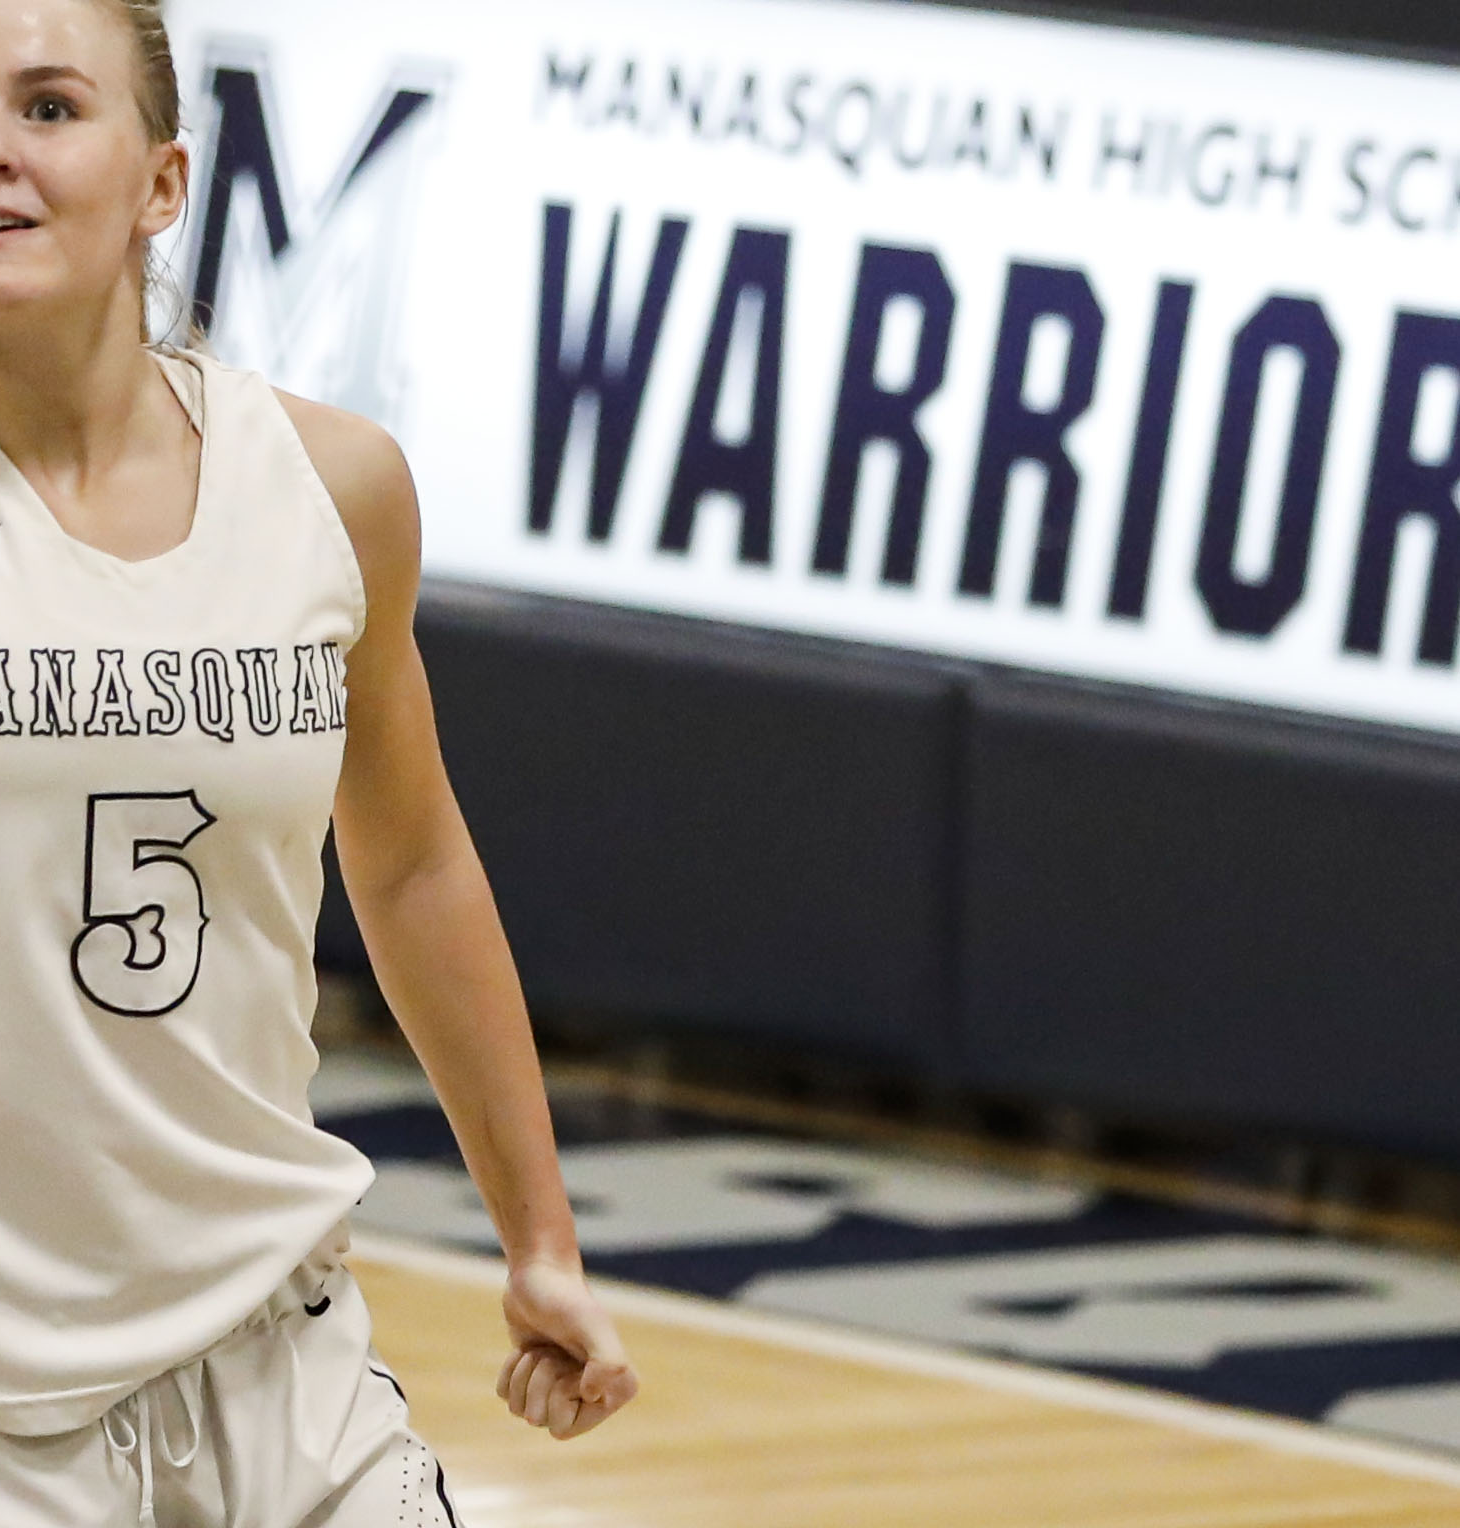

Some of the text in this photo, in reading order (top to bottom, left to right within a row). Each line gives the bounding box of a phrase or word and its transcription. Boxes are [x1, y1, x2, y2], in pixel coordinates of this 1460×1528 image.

[533, 42, 1073, 182] MANASQUAN
[1089, 104, 1313, 216] HIGH
[527, 200, 1460, 668] WARRIOR
[69, 787, 218, 1018] 5
